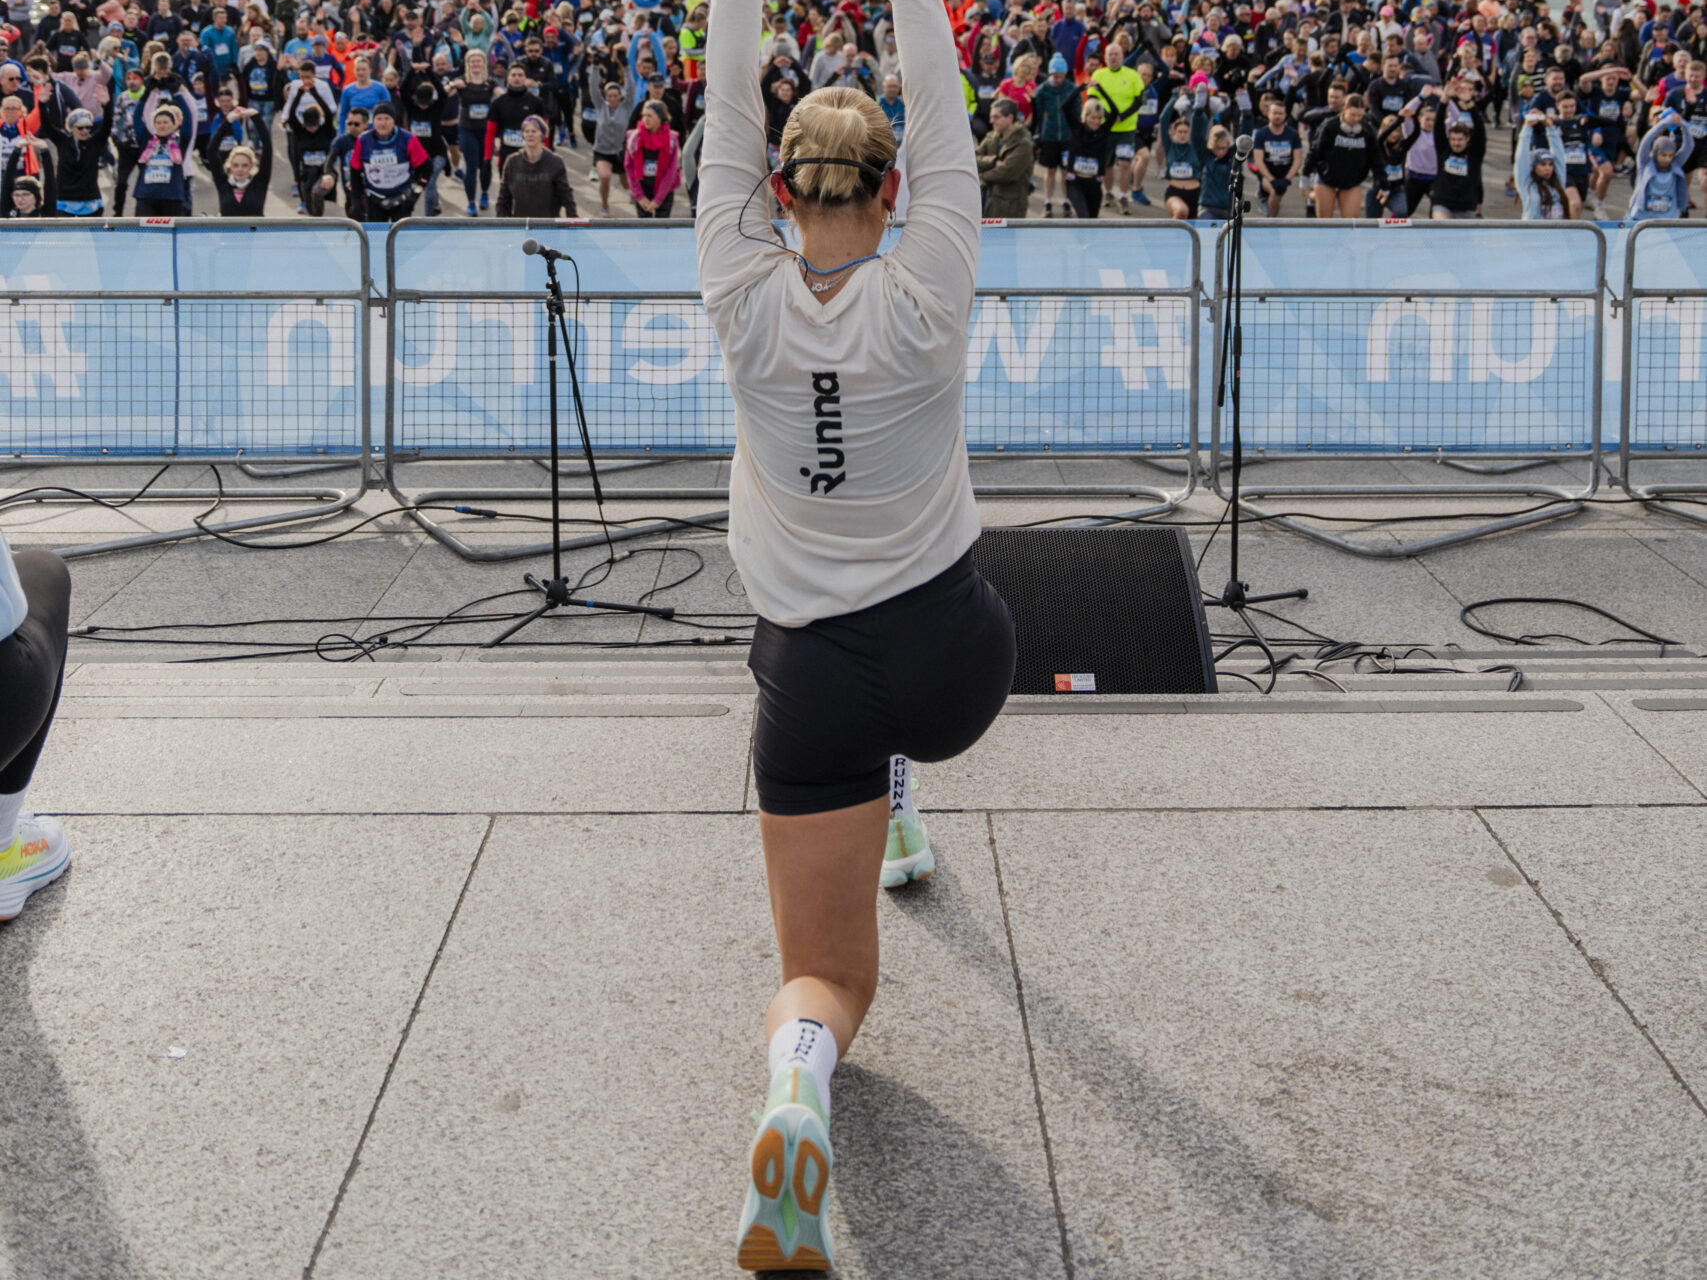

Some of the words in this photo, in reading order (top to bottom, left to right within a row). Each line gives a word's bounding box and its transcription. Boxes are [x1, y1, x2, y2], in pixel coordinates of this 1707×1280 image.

[800, 371, 846, 495] Runna
[891, 757, 906, 812] RUNNA
[20, 837, 50, 859] HOKA
